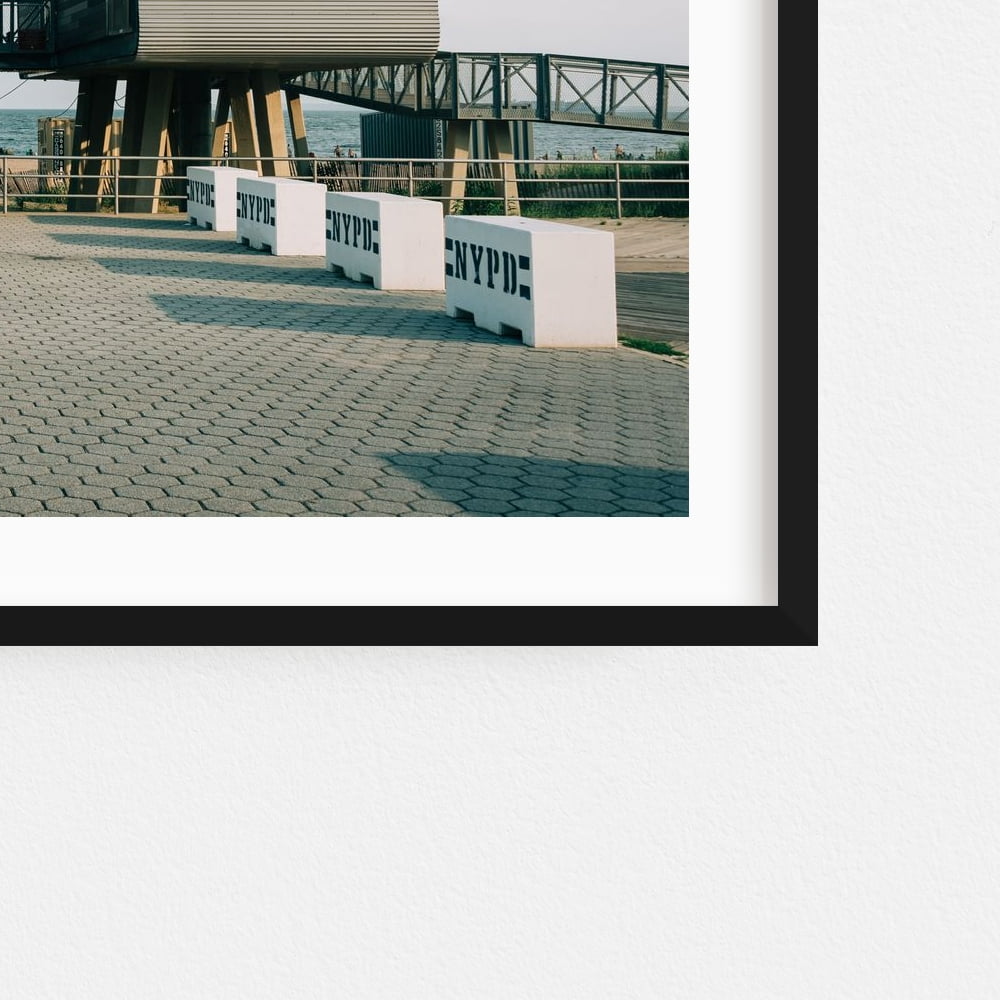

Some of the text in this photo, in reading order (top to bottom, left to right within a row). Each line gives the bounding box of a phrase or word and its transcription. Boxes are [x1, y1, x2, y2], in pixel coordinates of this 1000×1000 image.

[190, 180, 211, 206] NYPD
[241, 192, 270, 225] NYPD
[332, 210, 372, 251] NYPD
[454, 239, 517, 295] NYPD
